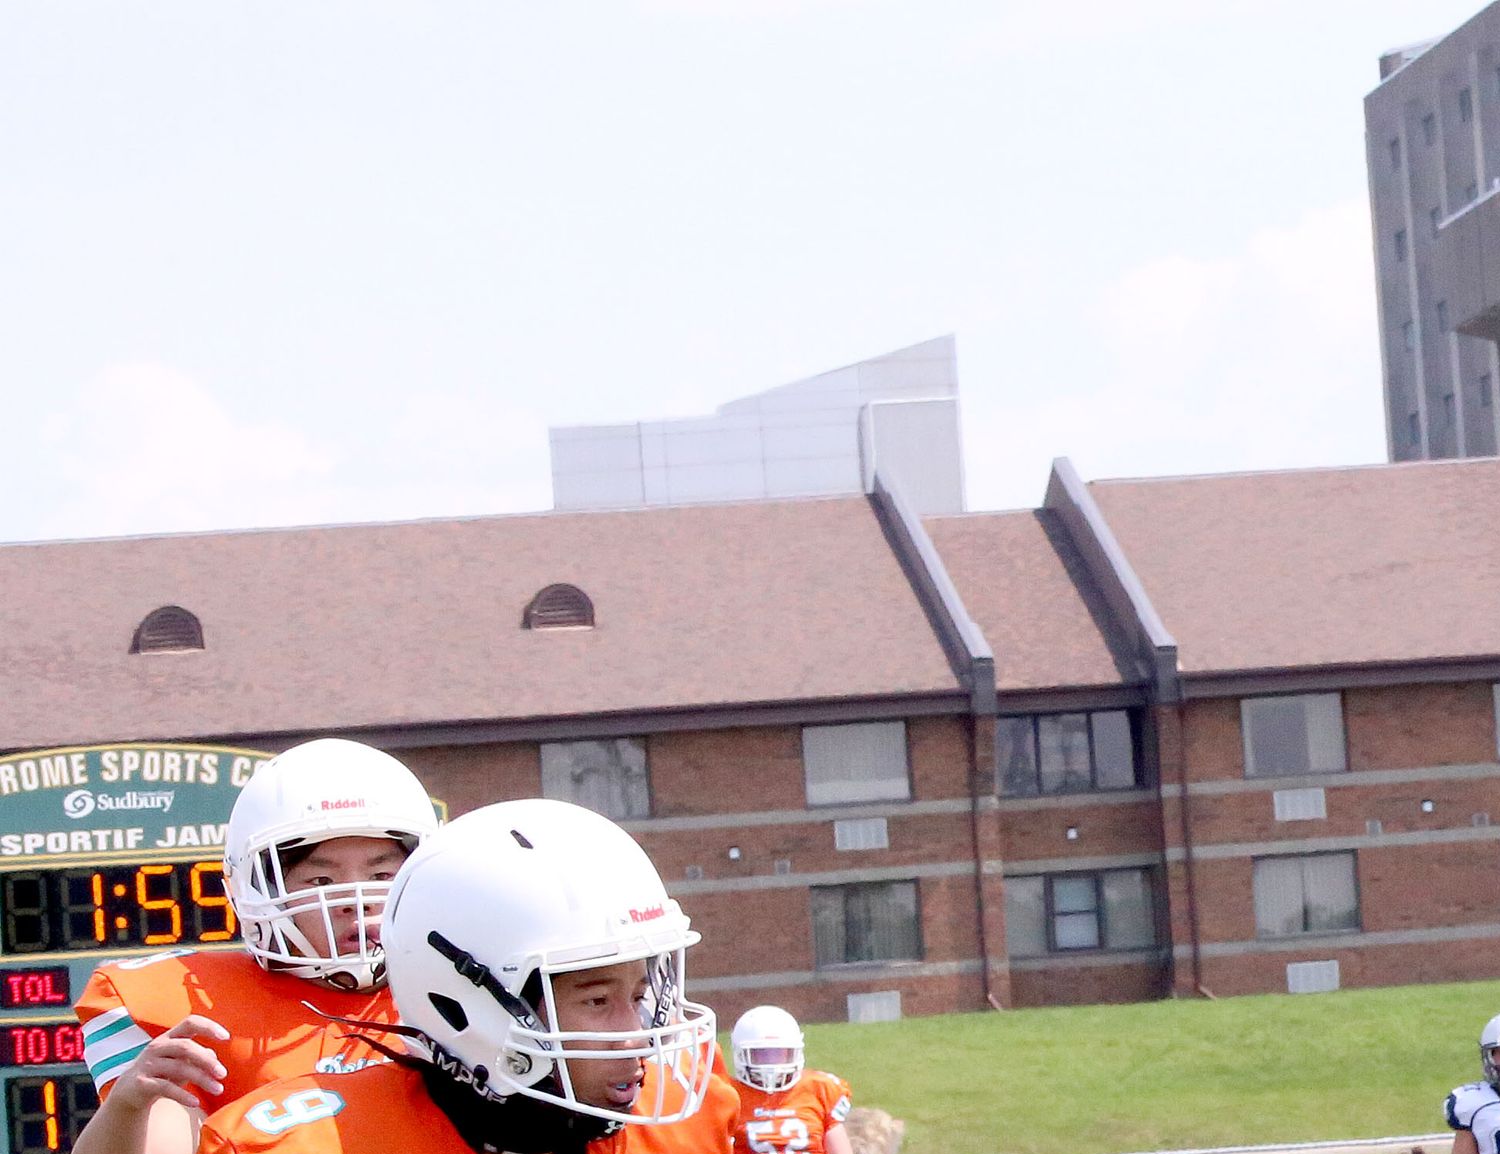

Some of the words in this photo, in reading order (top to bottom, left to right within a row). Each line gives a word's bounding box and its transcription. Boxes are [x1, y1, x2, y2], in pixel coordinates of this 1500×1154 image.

[102, 751, 218, 785] SPORTS
[97, 791, 175, 813] Sudbury
[321, 799, 365, 811] Riddell
[1, 828, 144, 855] SPORTIF
[8, 975, 65, 1003] TOL
[12, 1029, 47, 1064] TO
